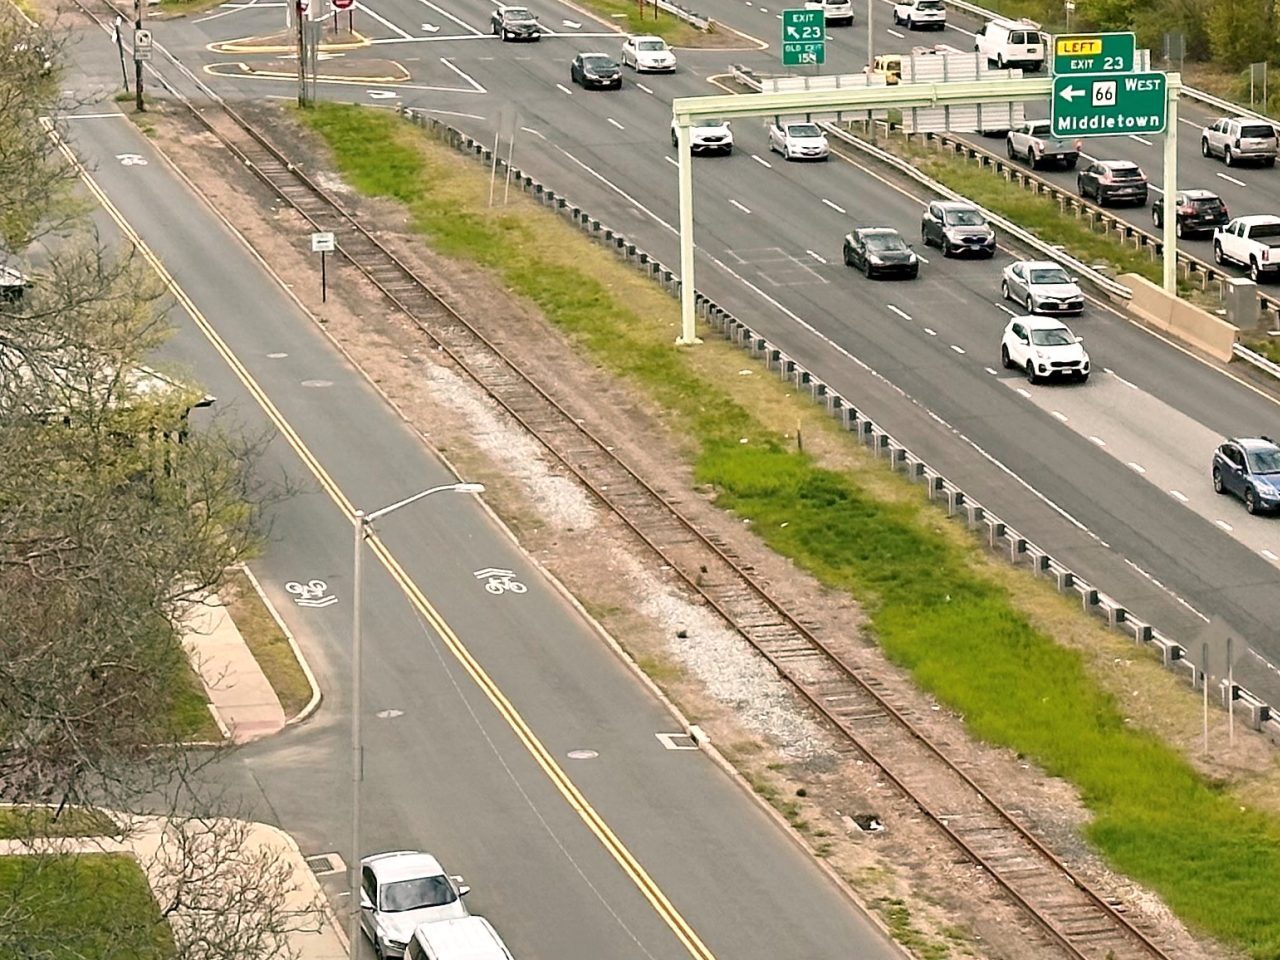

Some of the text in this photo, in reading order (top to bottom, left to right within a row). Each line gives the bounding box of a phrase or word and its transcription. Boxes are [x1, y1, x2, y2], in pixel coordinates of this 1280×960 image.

[792, 14, 814, 23] EXIT
[802, 26, 821, 38] 23
[785, 44, 801, 52] OLD
[1063, 42, 1095, 53] LEFT
[1070, 57, 1124, 70] EXIT 23
[1125, 78, 1161, 91] WEST
[1095, 87, 1113, 101] 66
[1058, 115, 1160, 131] Middletown
